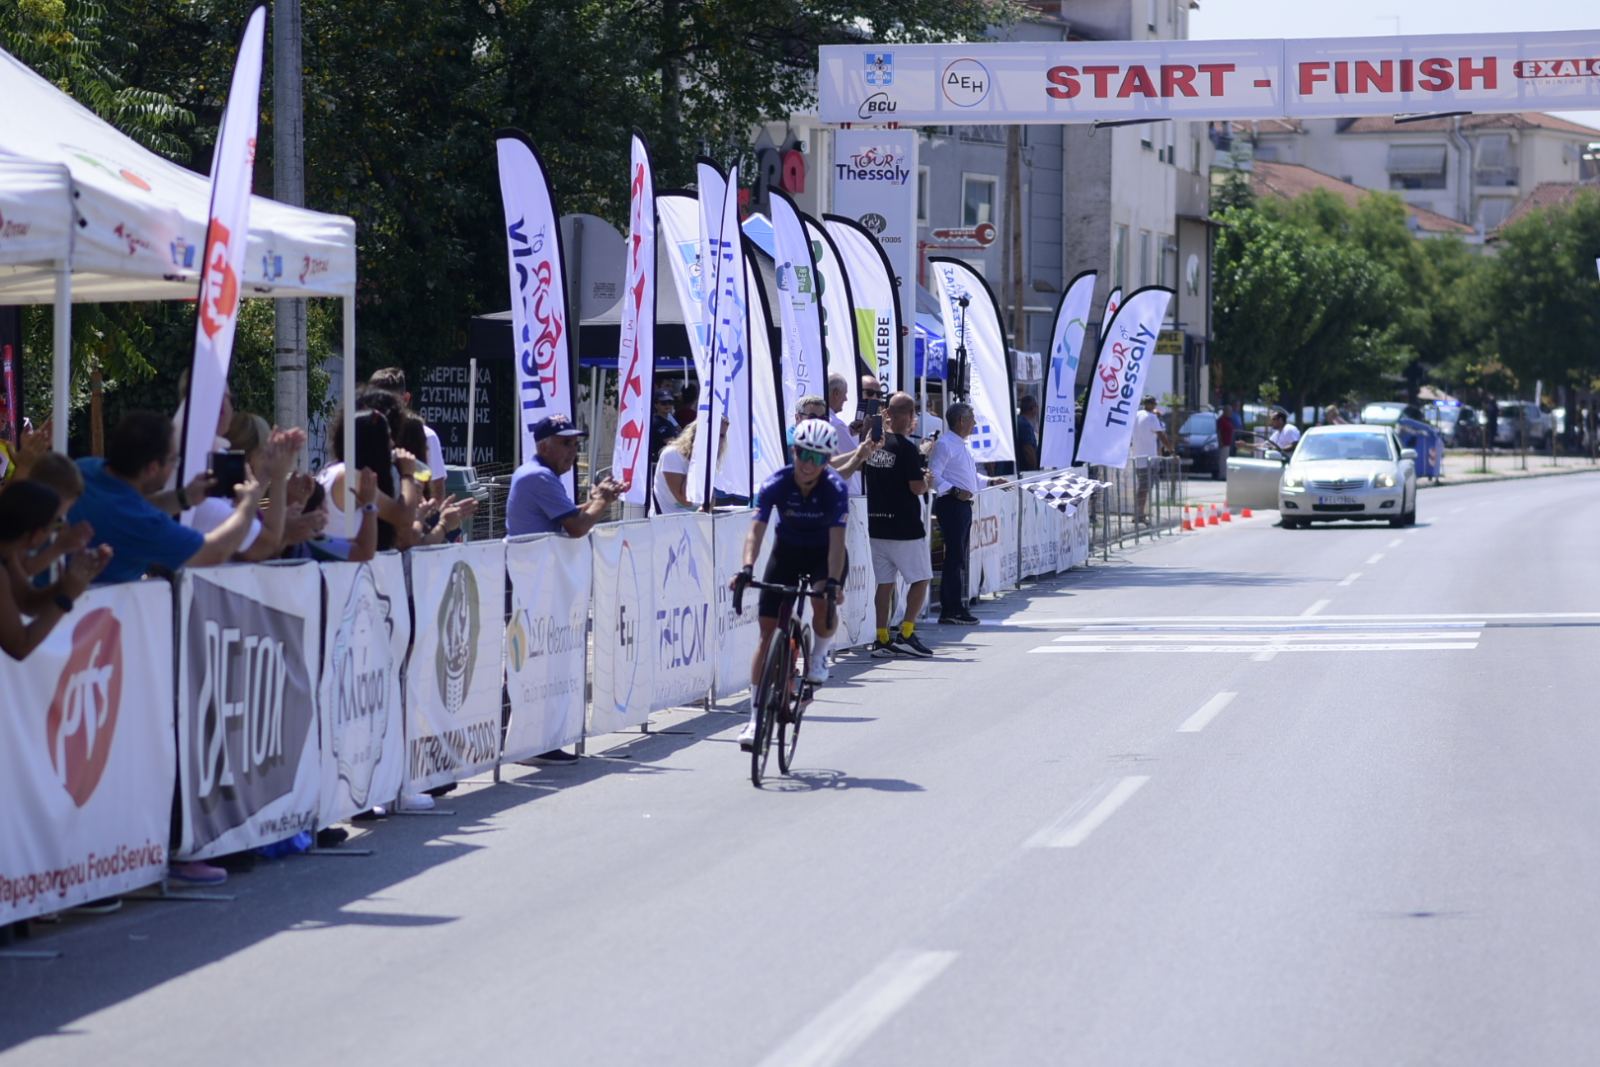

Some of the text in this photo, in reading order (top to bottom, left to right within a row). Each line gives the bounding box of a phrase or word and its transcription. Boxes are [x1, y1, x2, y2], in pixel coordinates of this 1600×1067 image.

[1046, 63, 1236, 100] START
[1299, 56, 1498, 95] FINISH
[868, 101, 897, 112] BCU
[835, 163, 910, 185] Thessaly
[850, 152, 894, 169] TOUR
[1099, 342, 1130, 404] TOUR
[1106, 324, 1156, 427] Thessaly
[420, 406, 491, 423] ΘΕΡΜΑΝΗΣ
[450, 426, 459, 443] &
[615, 605, 635, 662] ΕΗ
[197, 620, 286, 798] DE-TOX
[467, 720, 496, 764] FOODS
